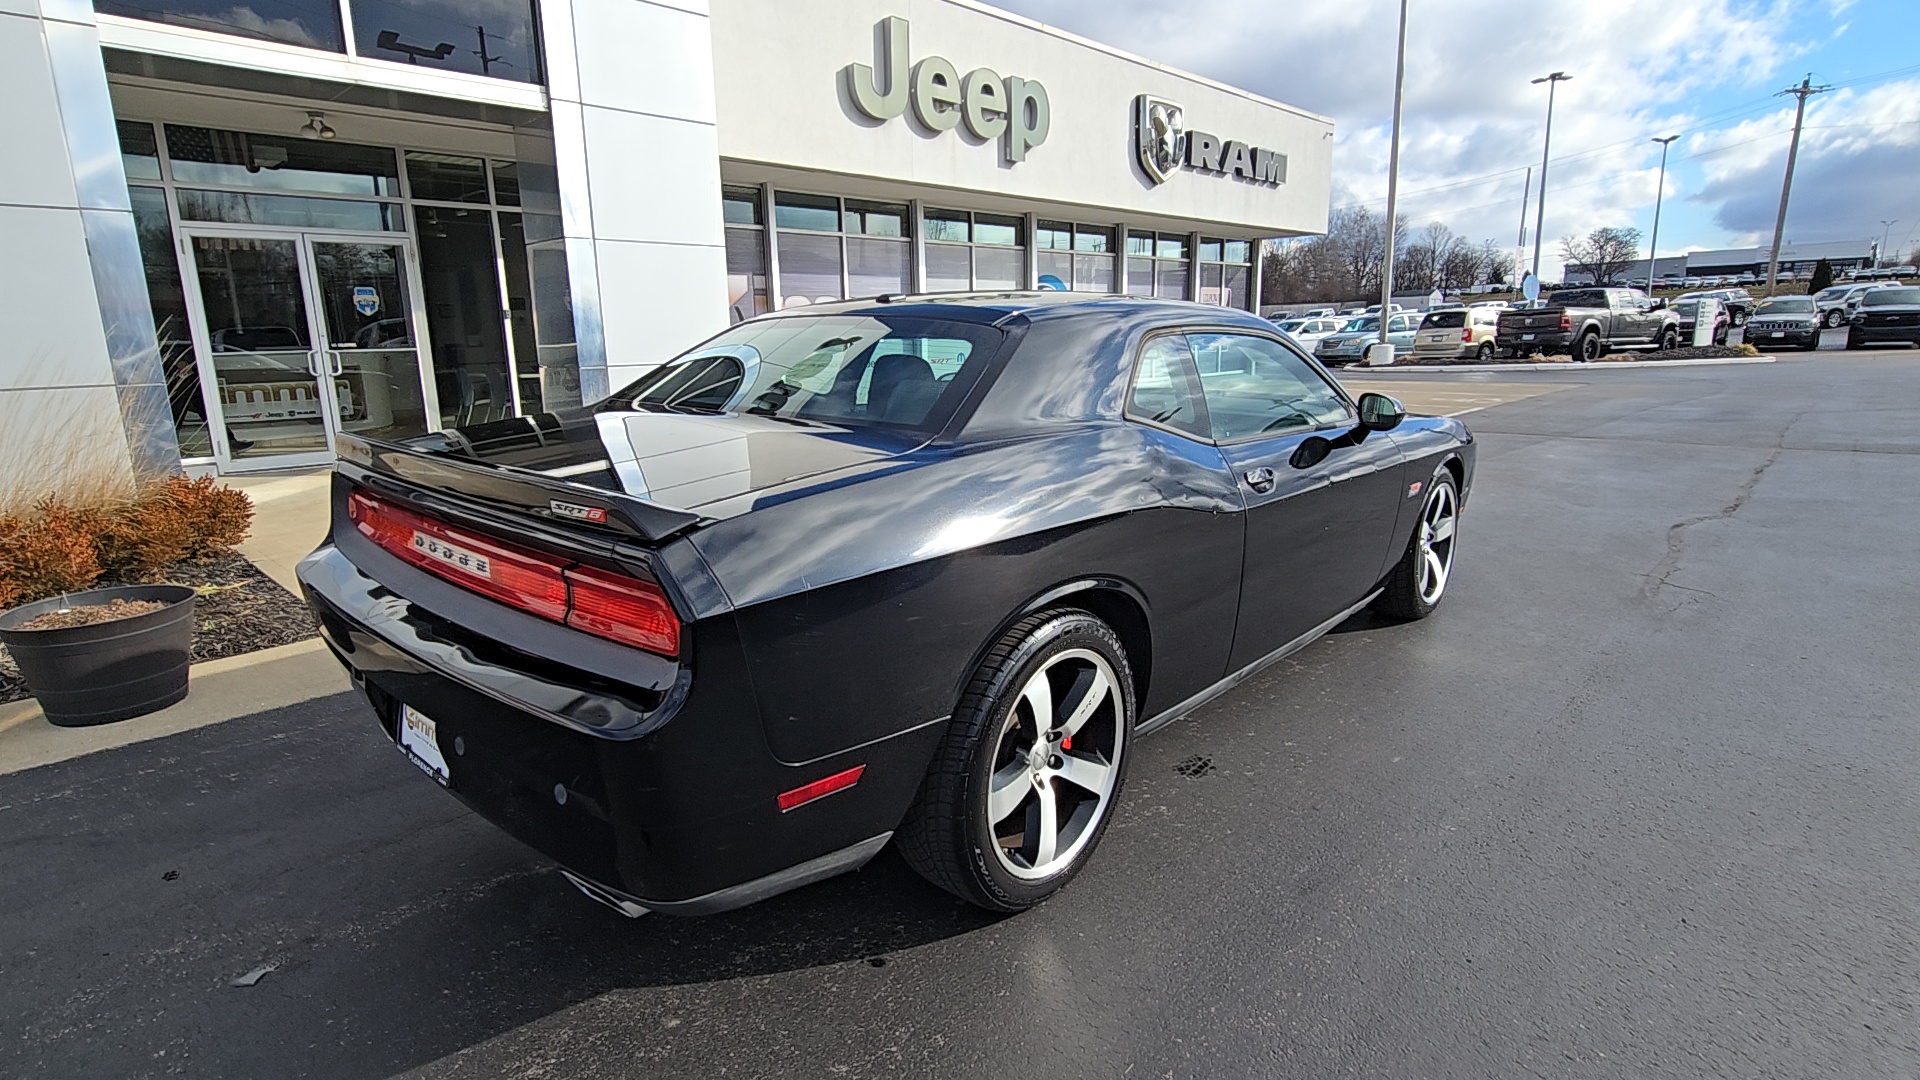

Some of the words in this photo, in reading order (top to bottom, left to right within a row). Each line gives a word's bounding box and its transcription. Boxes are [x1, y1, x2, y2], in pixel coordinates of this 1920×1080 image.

[840, 15, 1051, 163] Jeep
[1184, 129, 1288, 185] RAM
[219, 380, 348, 404] immr
[415, 535, 488, 573] DODGE
[408, 752, 434, 777] FLORENCE
